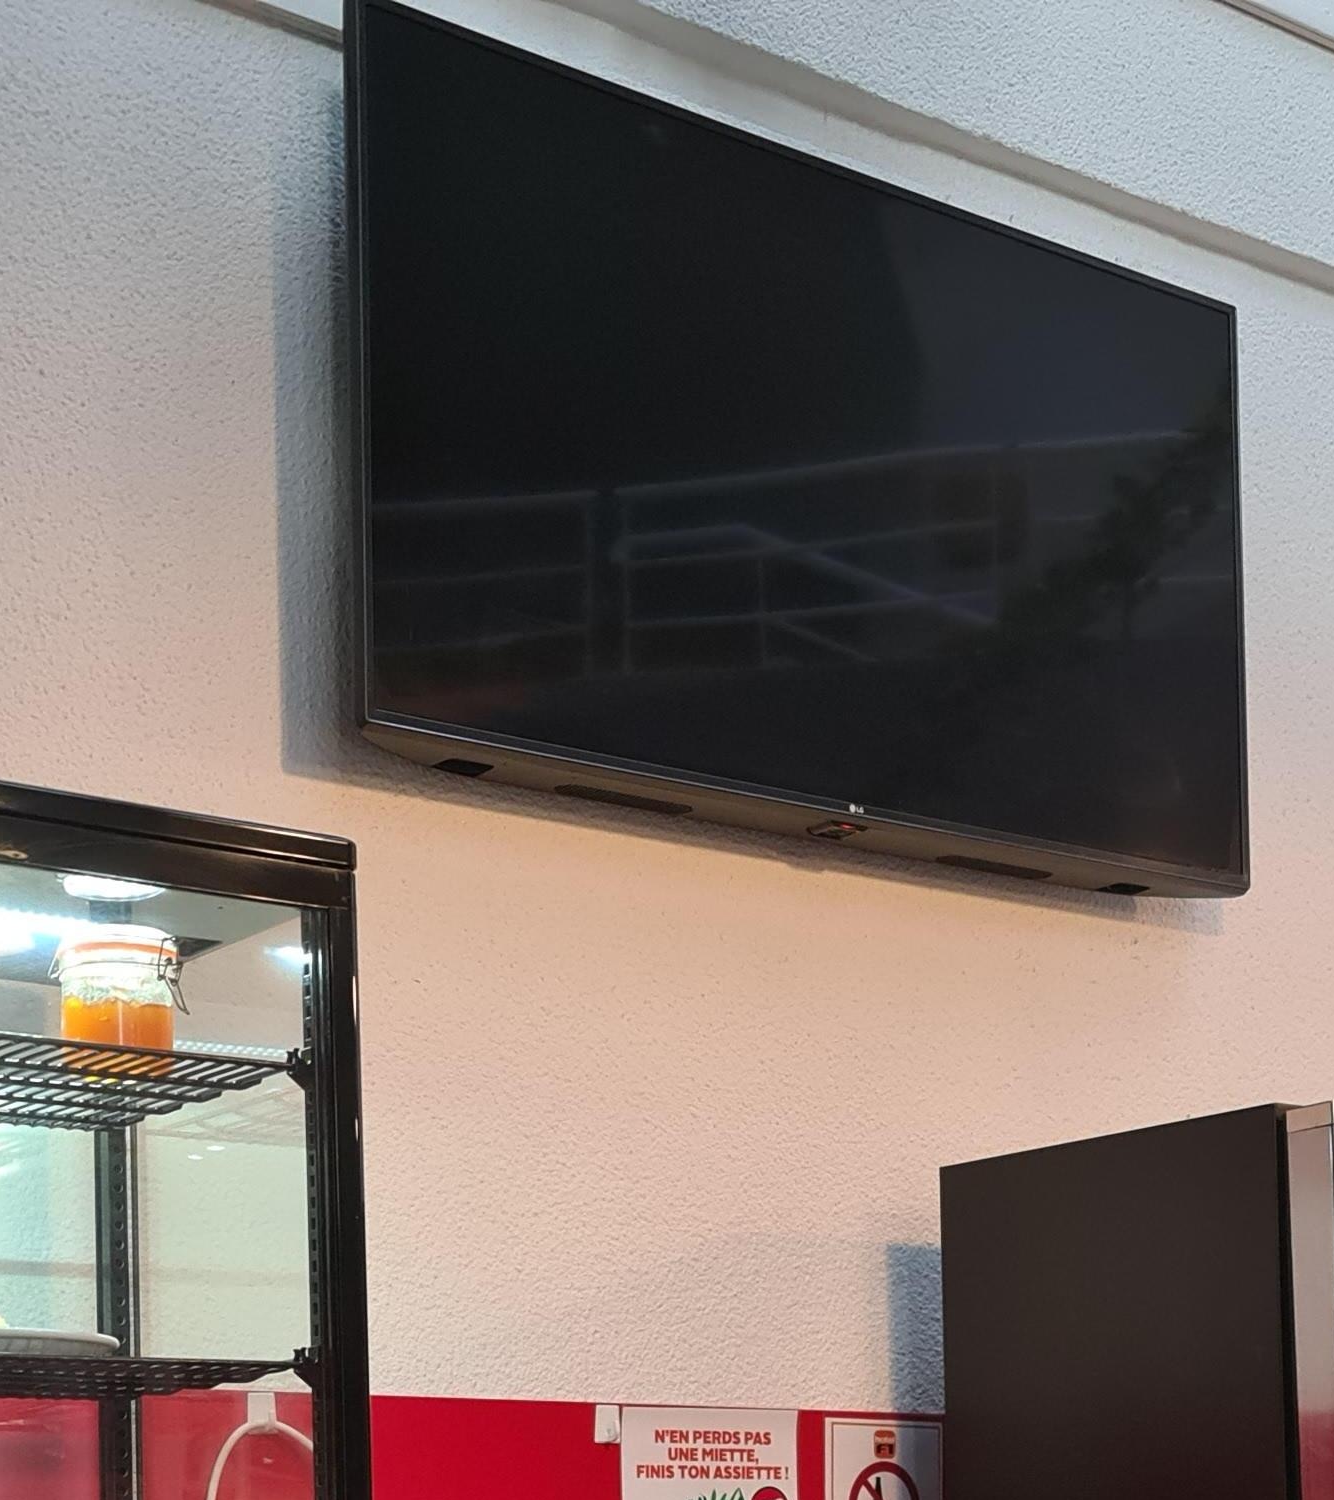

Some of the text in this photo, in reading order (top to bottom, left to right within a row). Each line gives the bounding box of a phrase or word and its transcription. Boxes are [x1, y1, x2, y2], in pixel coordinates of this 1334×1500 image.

[654, 1430, 772, 1446] N'EN PERDS PAS
[668, 1448, 760, 1464] UNE MIETTE,
[636, 1465, 674, 1479] FINIS
[678, 1465, 710, 1479] TON
[713, 1466, 782, 1480] ASSIETTE
